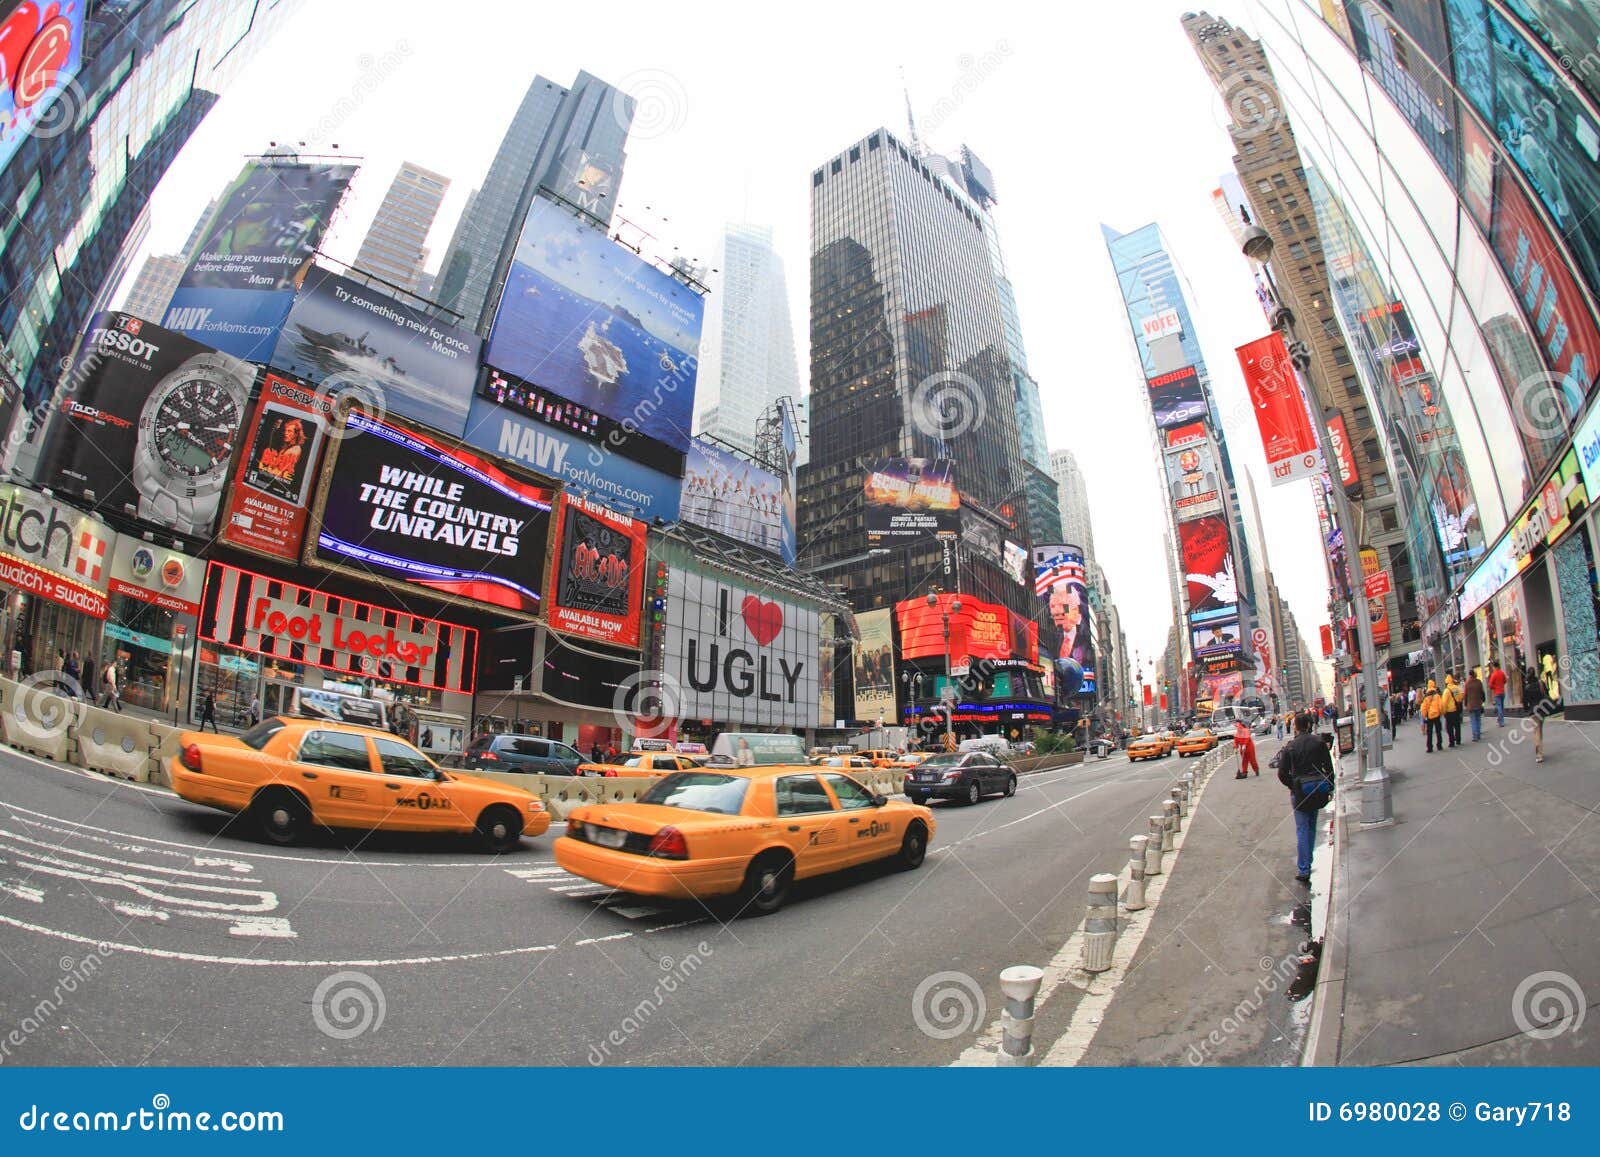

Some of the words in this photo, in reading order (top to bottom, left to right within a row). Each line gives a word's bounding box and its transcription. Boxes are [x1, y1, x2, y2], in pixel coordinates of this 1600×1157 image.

[193, 262, 220, 273] before
[199, 251, 222, 262] Make
[222, 254, 242, 263] sure
[242, 255, 260, 265] you
[262, 255, 285, 265] wash
[287, 256, 302, 267] up
[165, 308, 212, 331] NAVY
[335, 286, 351, 302] Try
[352, 295, 405, 326] something
[406, 319, 428, 334] new
[429, 327, 444, 342] for
[445, 335, 471, 354] once.
[1144, 314, 1178, 336] VOTE!
[91, 328, 160, 361] TISSOT
[1149, 368, 1195, 388] TOSHIBA
[498, 419, 569, 474] NAVY
[379, 464, 464, 502] WHILE
[1176, 490, 1218, 508] CHEVROLET
[244, 496, 278, 514] AVAILABLE
[359, 483, 410, 511] THE
[413, 496, 525, 537] COUNTRY
[566, 493, 582, 507] THE
[584, 500, 604, 518] NEW
[605, 509, 633, 528] ALBUM
[370, 508, 519, 557] UNRAVELS
[558, 608, 600, 628] AVAILABLE
[601, 619, 622, 633] NOW
[719, 588, 728, 636] I
[253, 597, 322, 645] Foot
[332, 617, 433, 667] Locker
[687, 638, 804, 704] UGLY
